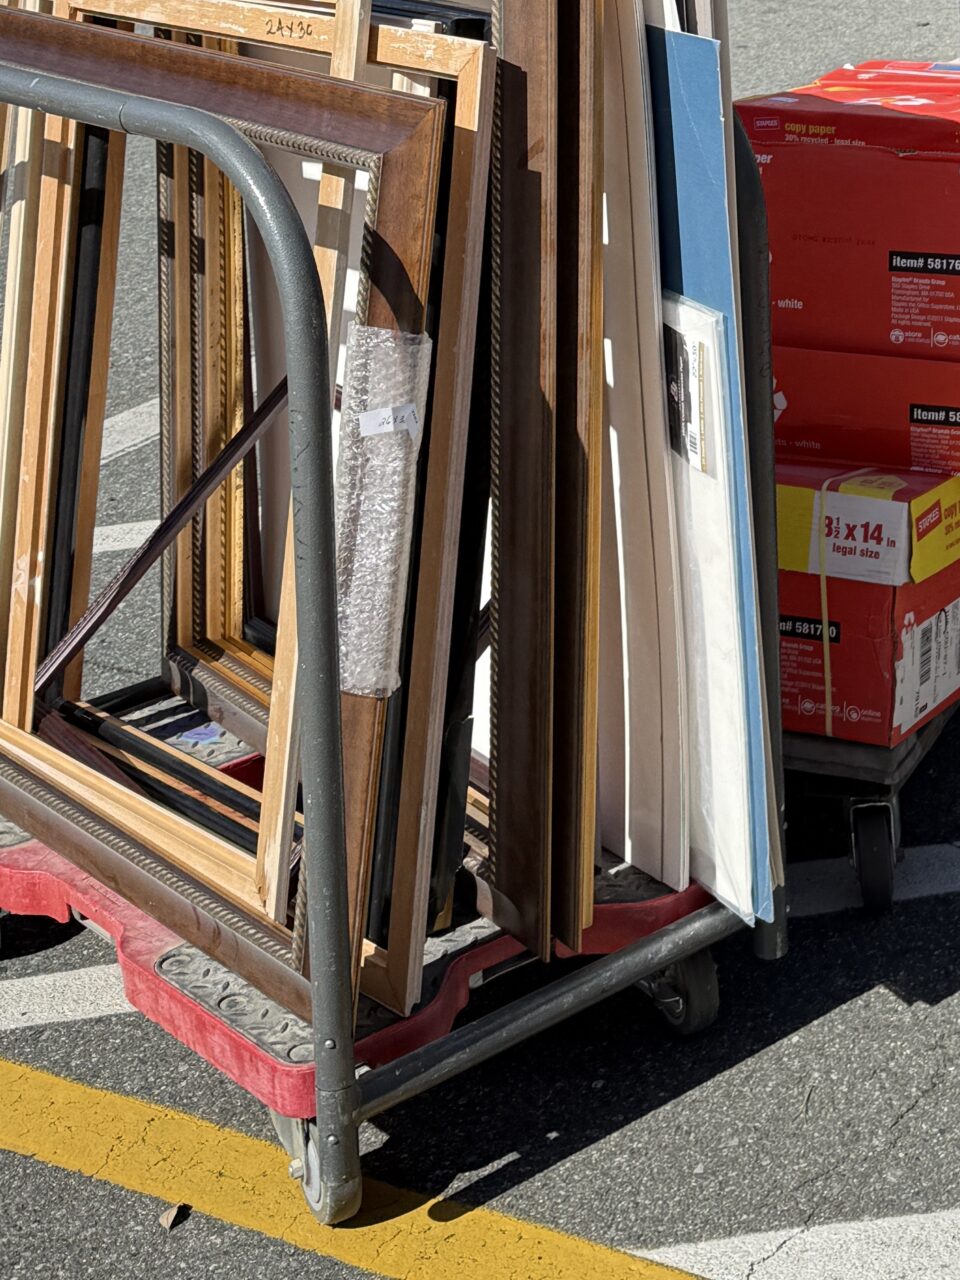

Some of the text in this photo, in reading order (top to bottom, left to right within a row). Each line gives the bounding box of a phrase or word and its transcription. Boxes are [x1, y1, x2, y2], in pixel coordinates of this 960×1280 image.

[785, 122, 836, 134] copy paper
[800, 135, 829, 145] recycled
[892, 255, 924, 269] item#
[778, 299, 803, 310] white
[913, 408, 946, 421] item#
[794, 440, 821, 450] white
[918, 508, 939, 532] STAPLES
[860, 522, 883, 545] 14
[832, 542, 880, 559] legal size
[795, 622, 836, 638] 58170
